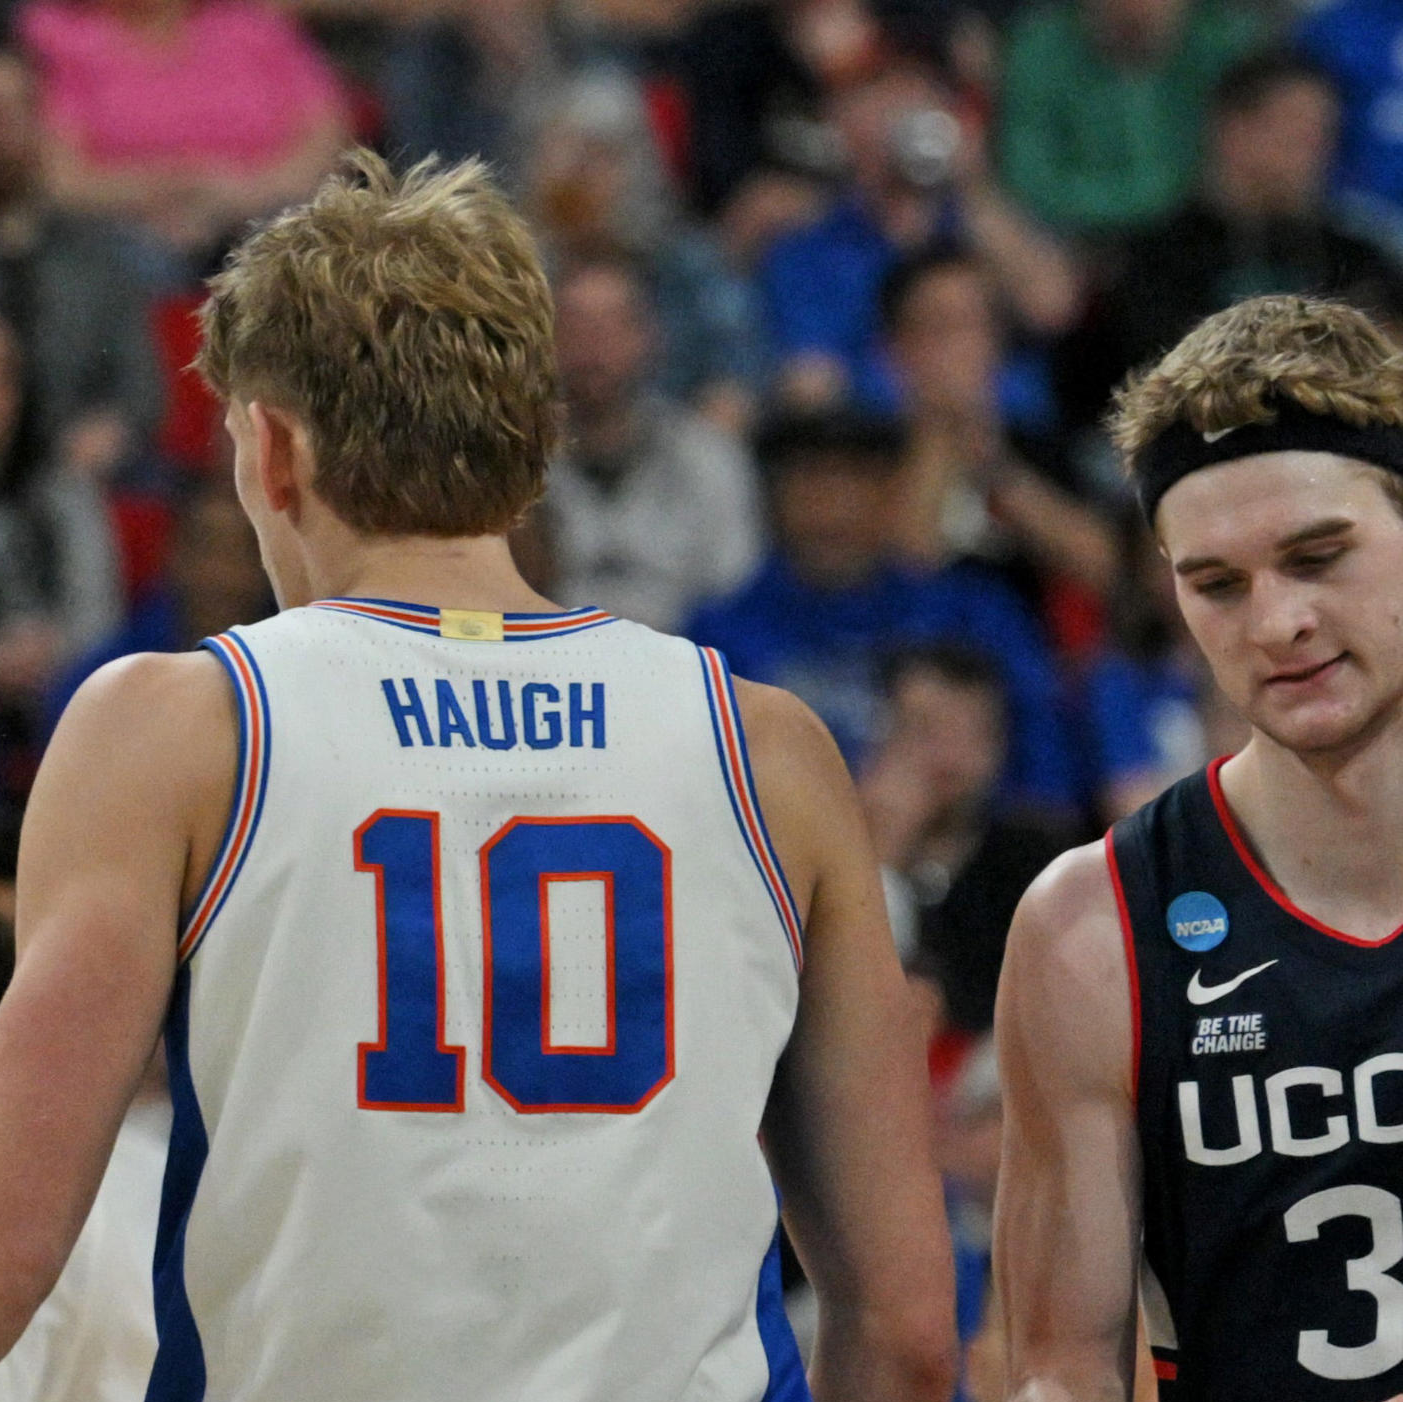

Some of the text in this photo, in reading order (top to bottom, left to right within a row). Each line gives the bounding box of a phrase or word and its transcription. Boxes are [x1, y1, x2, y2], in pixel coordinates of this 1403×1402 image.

[381, 678, 606, 751] HAUGH
[1176, 918, 1226, 937] NCAA
[353, 808, 675, 1115] 10
[1198, 1014, 1263, 1036] BE THE
[1192, 1032, 1266, 1055] CHANGE
